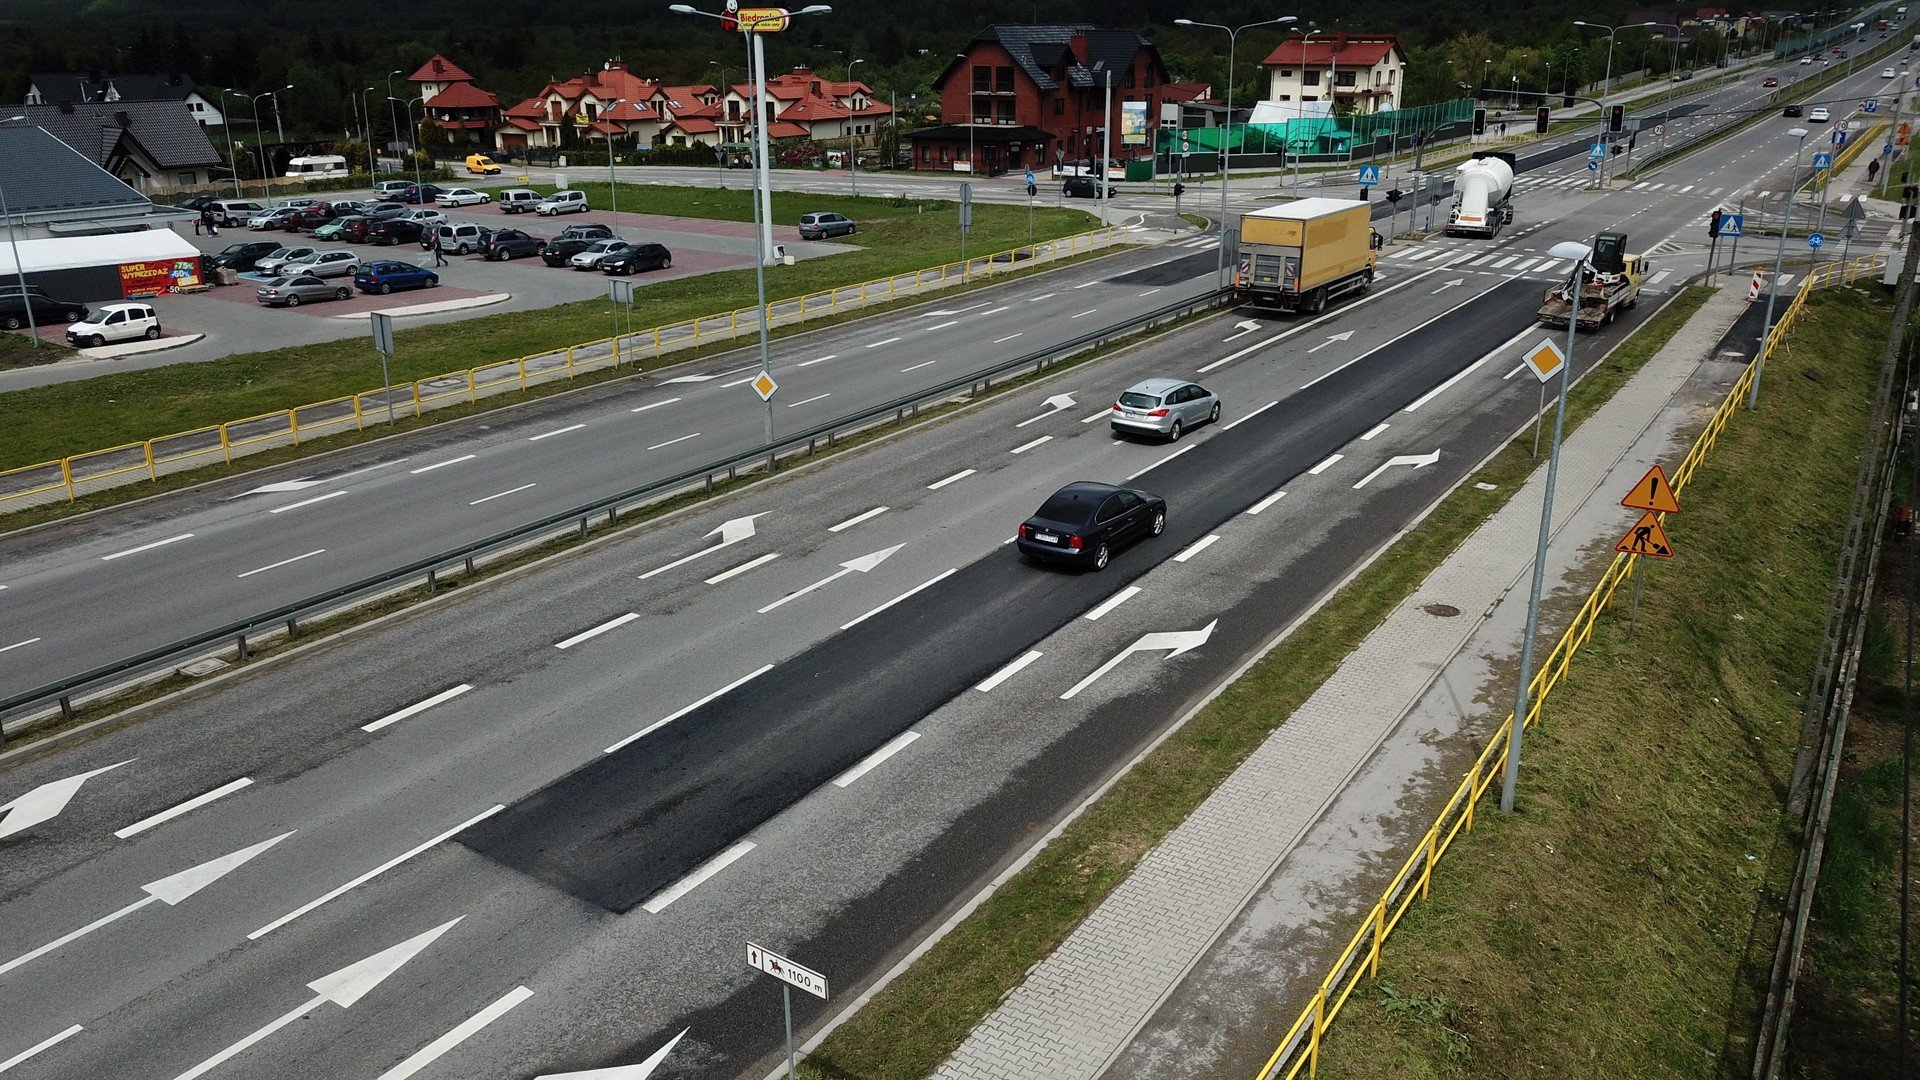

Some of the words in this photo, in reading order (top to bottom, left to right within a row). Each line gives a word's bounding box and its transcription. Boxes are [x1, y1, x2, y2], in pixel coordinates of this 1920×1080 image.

[121, 264, 145, 272] SUPER
[122, 266, 168, 279] WYPRZEDAŻ
[788, 969, 811, 987] 1100
[814, 984, 823, 993] m
